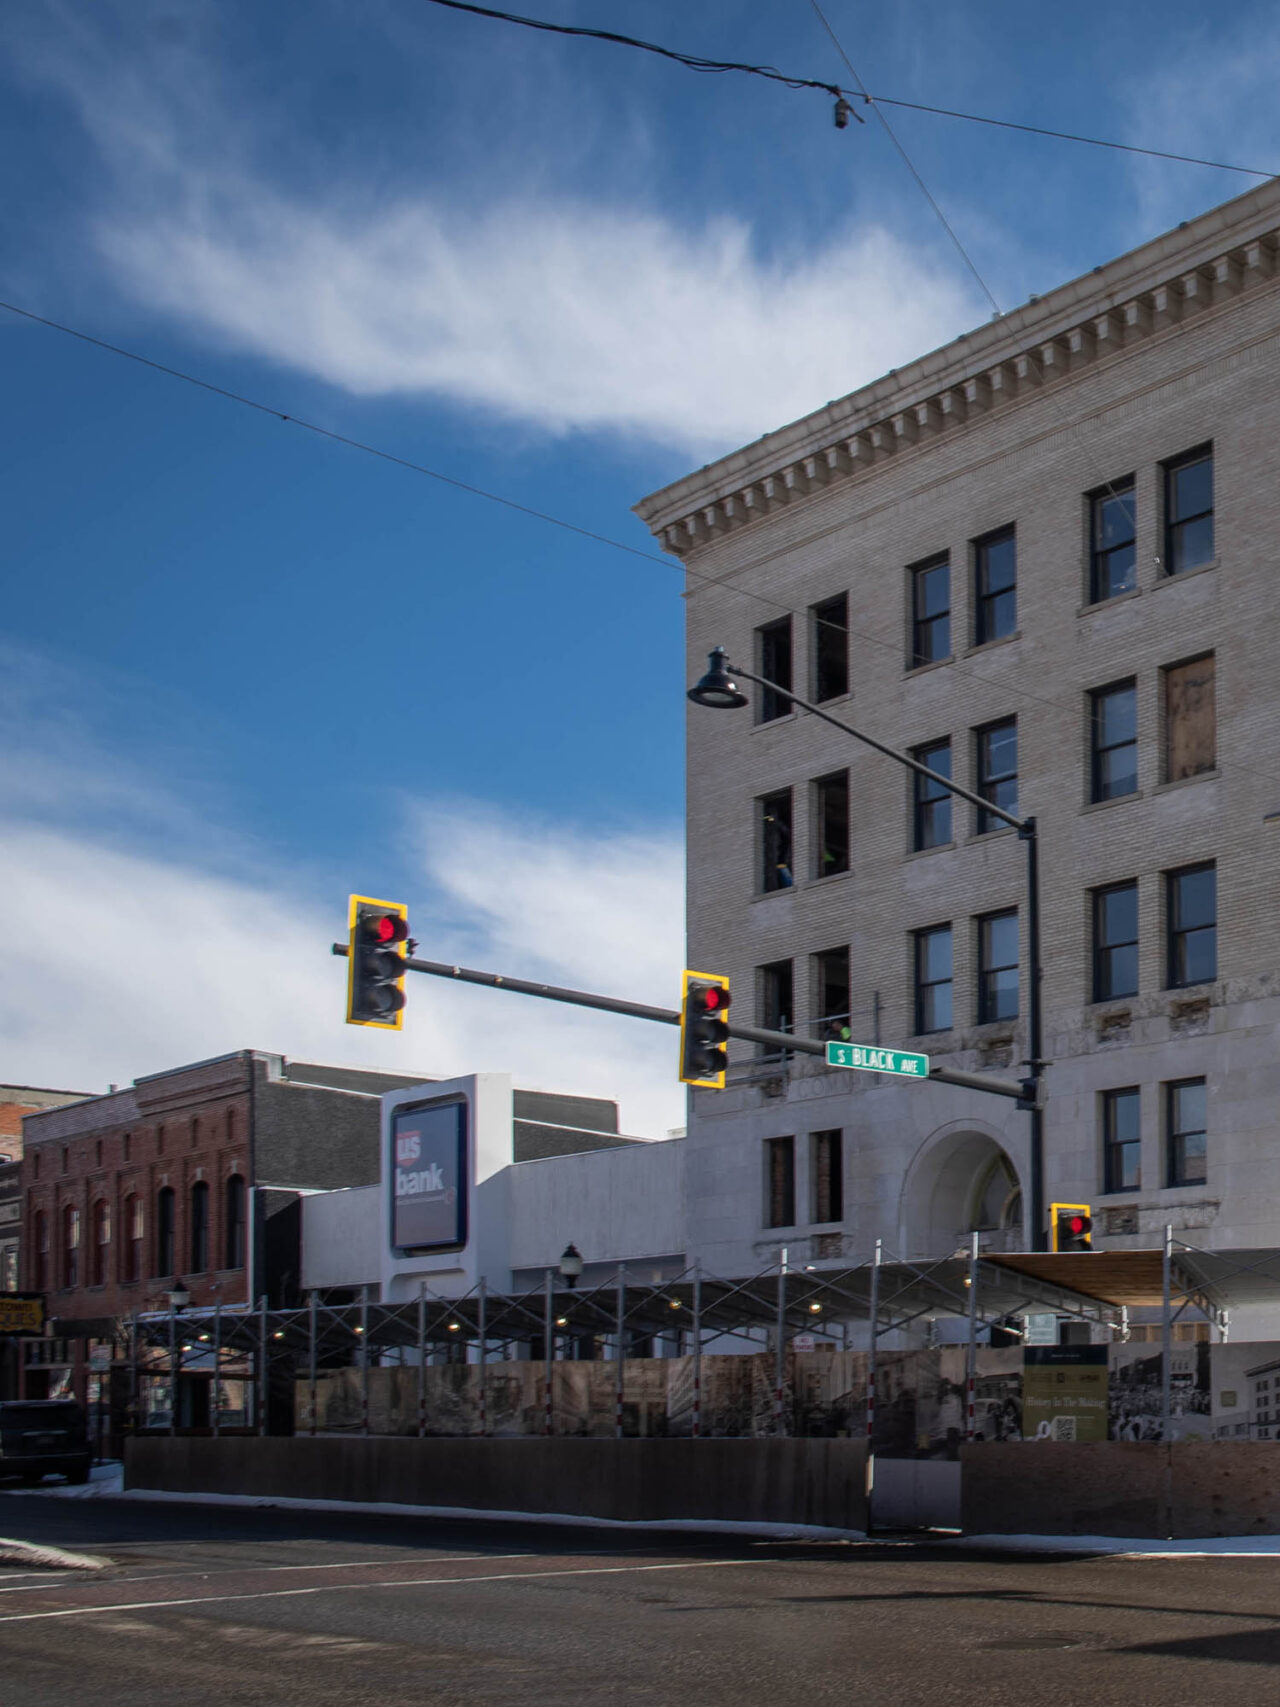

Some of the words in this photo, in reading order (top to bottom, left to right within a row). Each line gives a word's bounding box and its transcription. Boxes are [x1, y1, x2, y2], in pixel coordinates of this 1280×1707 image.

[837, 1049, 846, 1063] S
[852, 1048, 895, 1070] BLACK
[900, 1059, 919, 1073] AVE
[395, 1163, 444, 1196] bank
